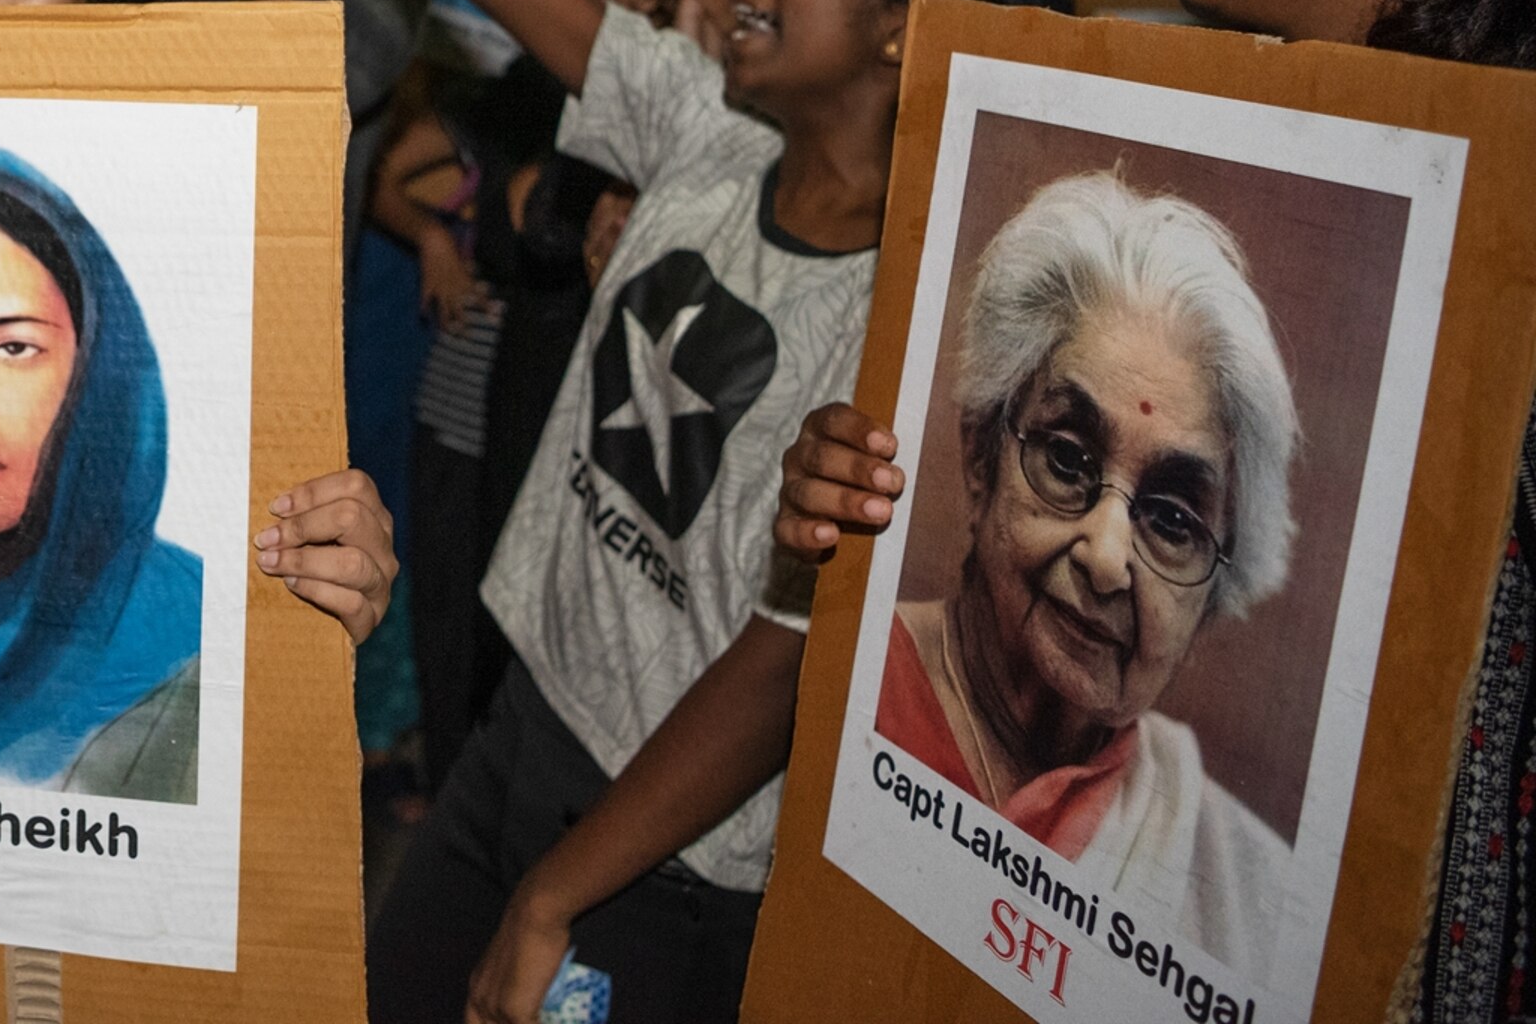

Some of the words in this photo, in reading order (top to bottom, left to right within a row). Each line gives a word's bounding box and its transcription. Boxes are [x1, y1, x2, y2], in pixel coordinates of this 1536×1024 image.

[570, 450, 689, 611] VERSE
[872, 750, 945, 830] Capt
[951, 801, 1100, 937] Lakshmi
[1107, 911, 1256, 1024] Sehgal
[983, 897, 1073, 1008] SFI
